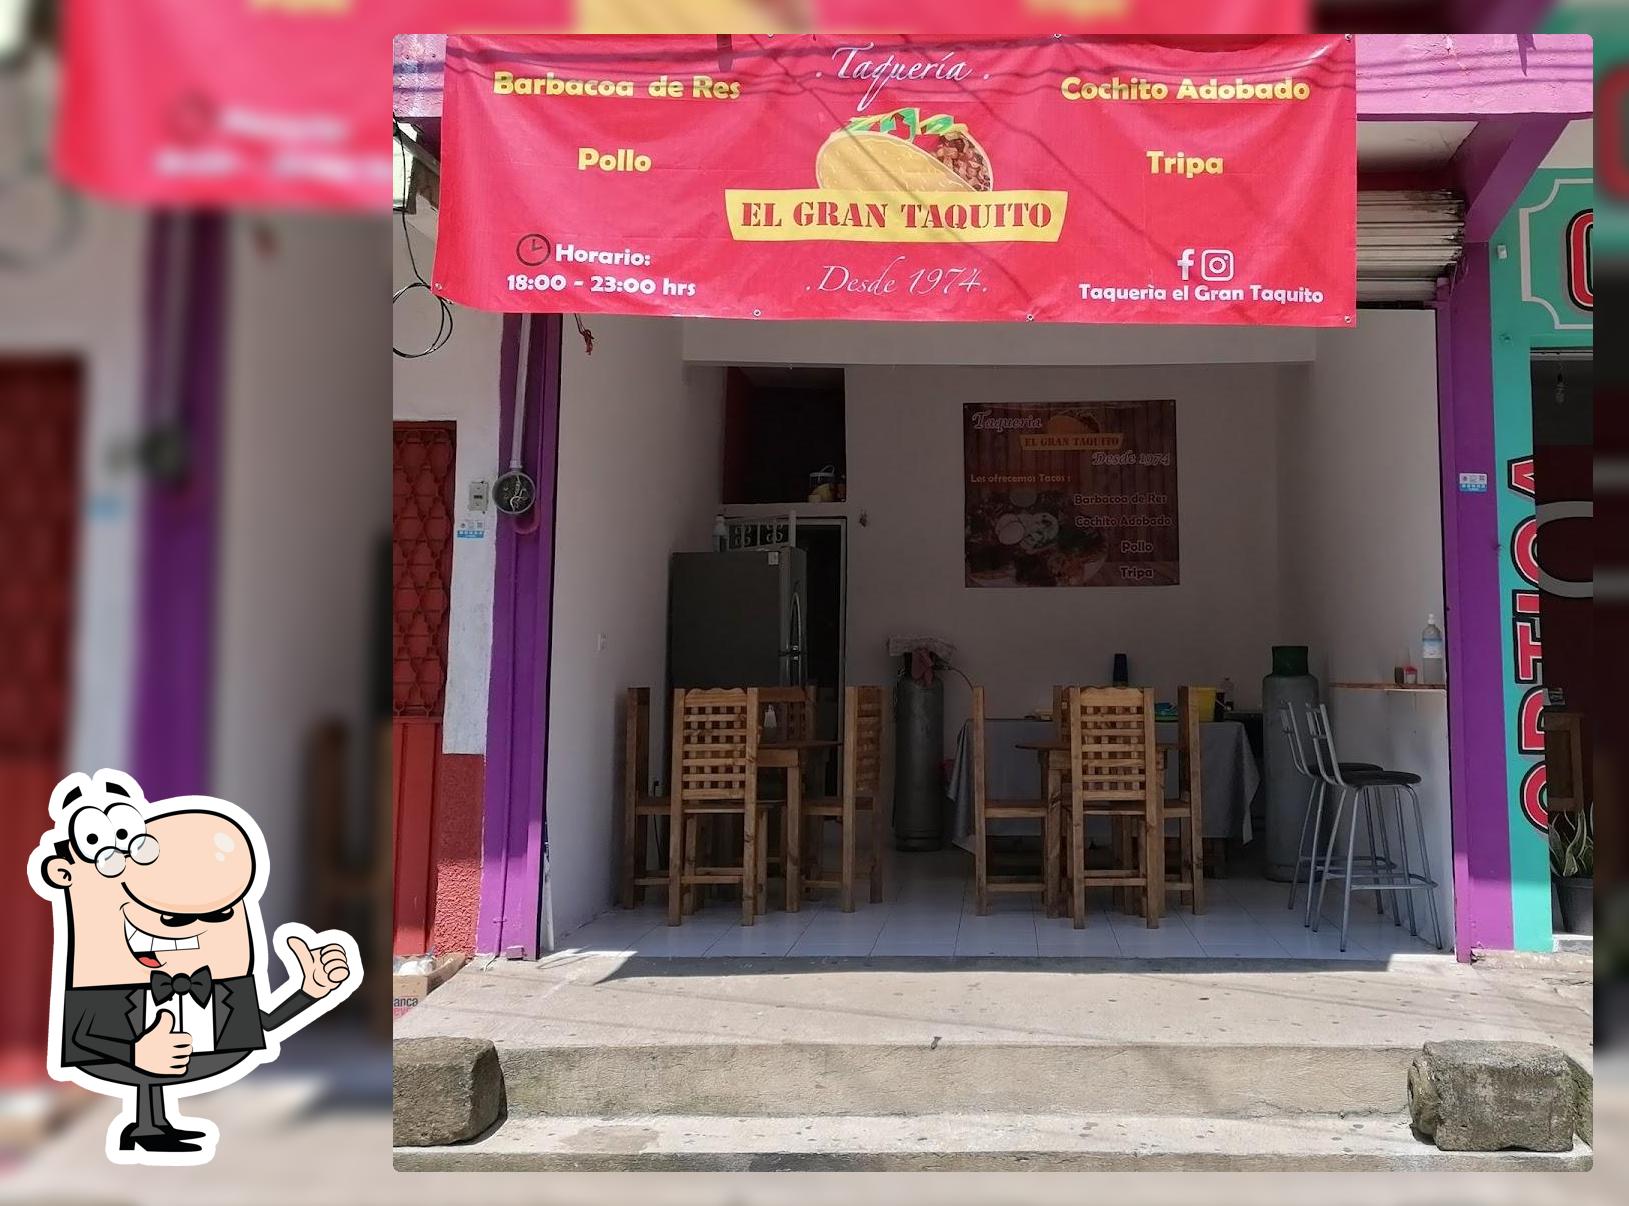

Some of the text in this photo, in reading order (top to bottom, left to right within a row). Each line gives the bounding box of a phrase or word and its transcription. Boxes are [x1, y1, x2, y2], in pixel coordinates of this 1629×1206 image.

[493, 71, 741, 101] Barbacoa de Res
[832, 42, 972, 111] Taquería
[1060, 76, 1311, 101] Cochito Adobado
[577, 147, 652, 172] Pollo
[1146, 150, 1225, 179] Tripa
[741, 201, 1051, 229] EL GRAN TAQUITO
[555, 243, 651, 266] Horario:
[507, 274, 567, 291] 18:00
[590, 275, 656, 295] 23:00
[662, 277, 696, 297] hrs
[1172, 285, 1189, 301] el
[1194, 285, 1244, 301] Gran
[1250, 285, 1324, 304] Taquito
[1024, 436, 1119, 447] EL GRAN TAQUITO
[1092, 450, 1136, 466] Desde
[1074, 494, 1128, 505] Barbacoa
[1130, 494, 1145, 504] de
[1075, 515, 1172, 528] Cochito Adobado
[1120, 540, 1153, 553] Pollo
[1120, 567, 1153, 580] Tripa
